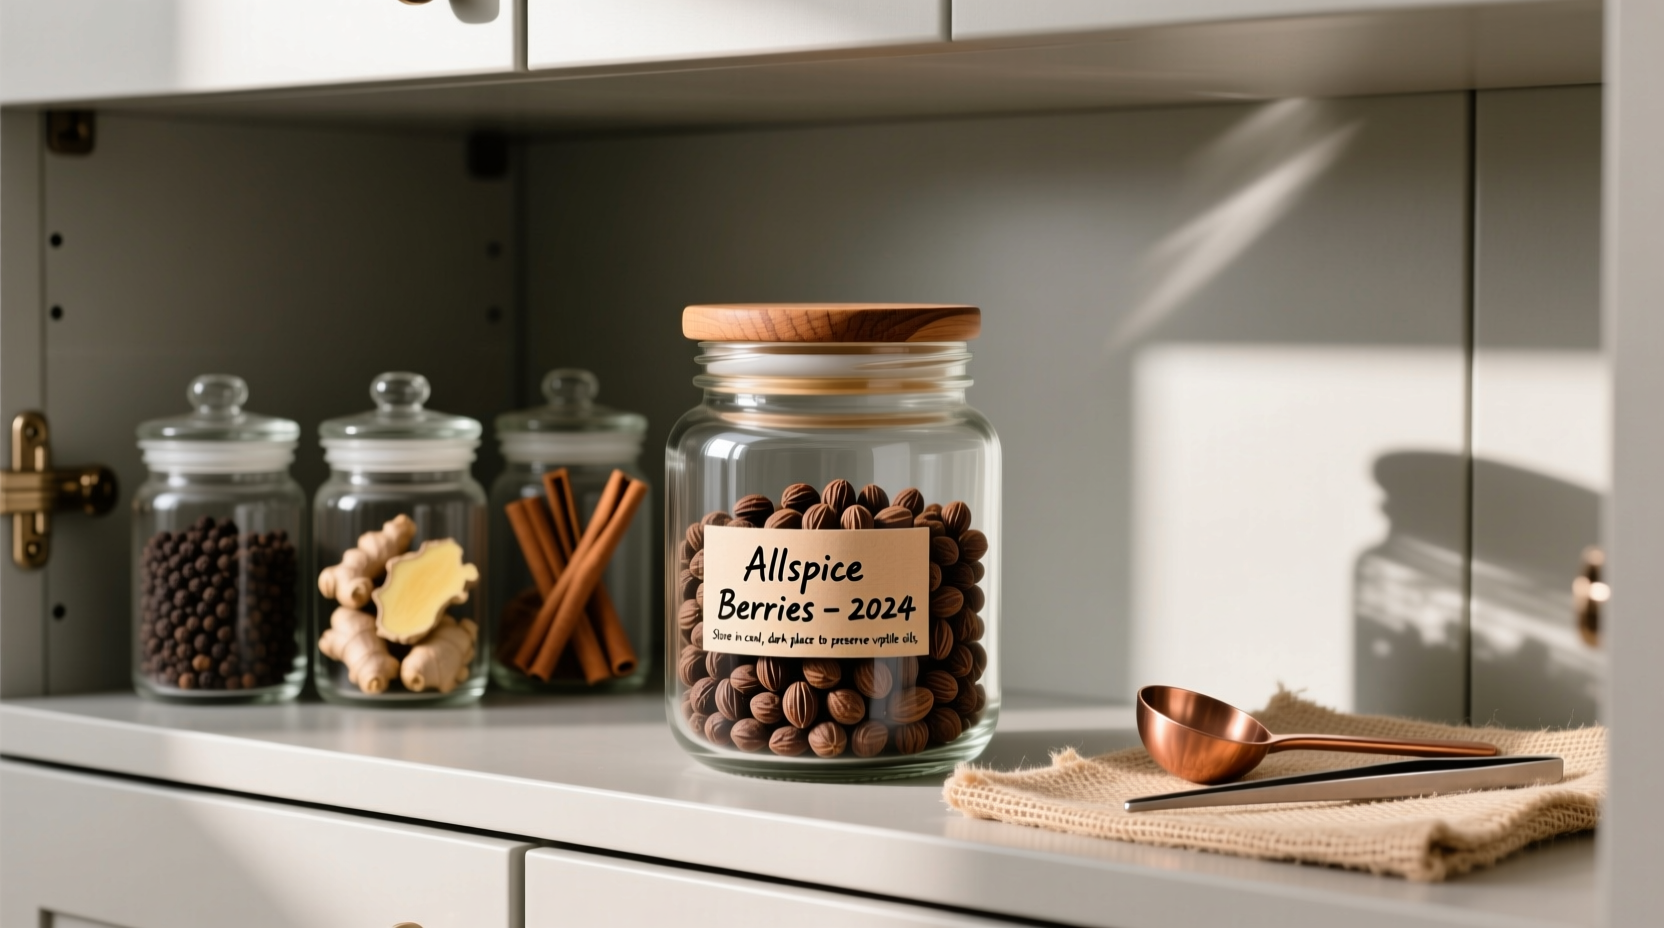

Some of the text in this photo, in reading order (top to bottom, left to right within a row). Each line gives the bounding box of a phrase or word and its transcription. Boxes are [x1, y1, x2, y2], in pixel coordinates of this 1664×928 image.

[743, 545, 864, 595] Allspice
[717, 588, 815, 622] Berries
[848, 595, 916, 621] 2024
[735, 632, 742, 642] in
[819, 635, 828, 645] to
